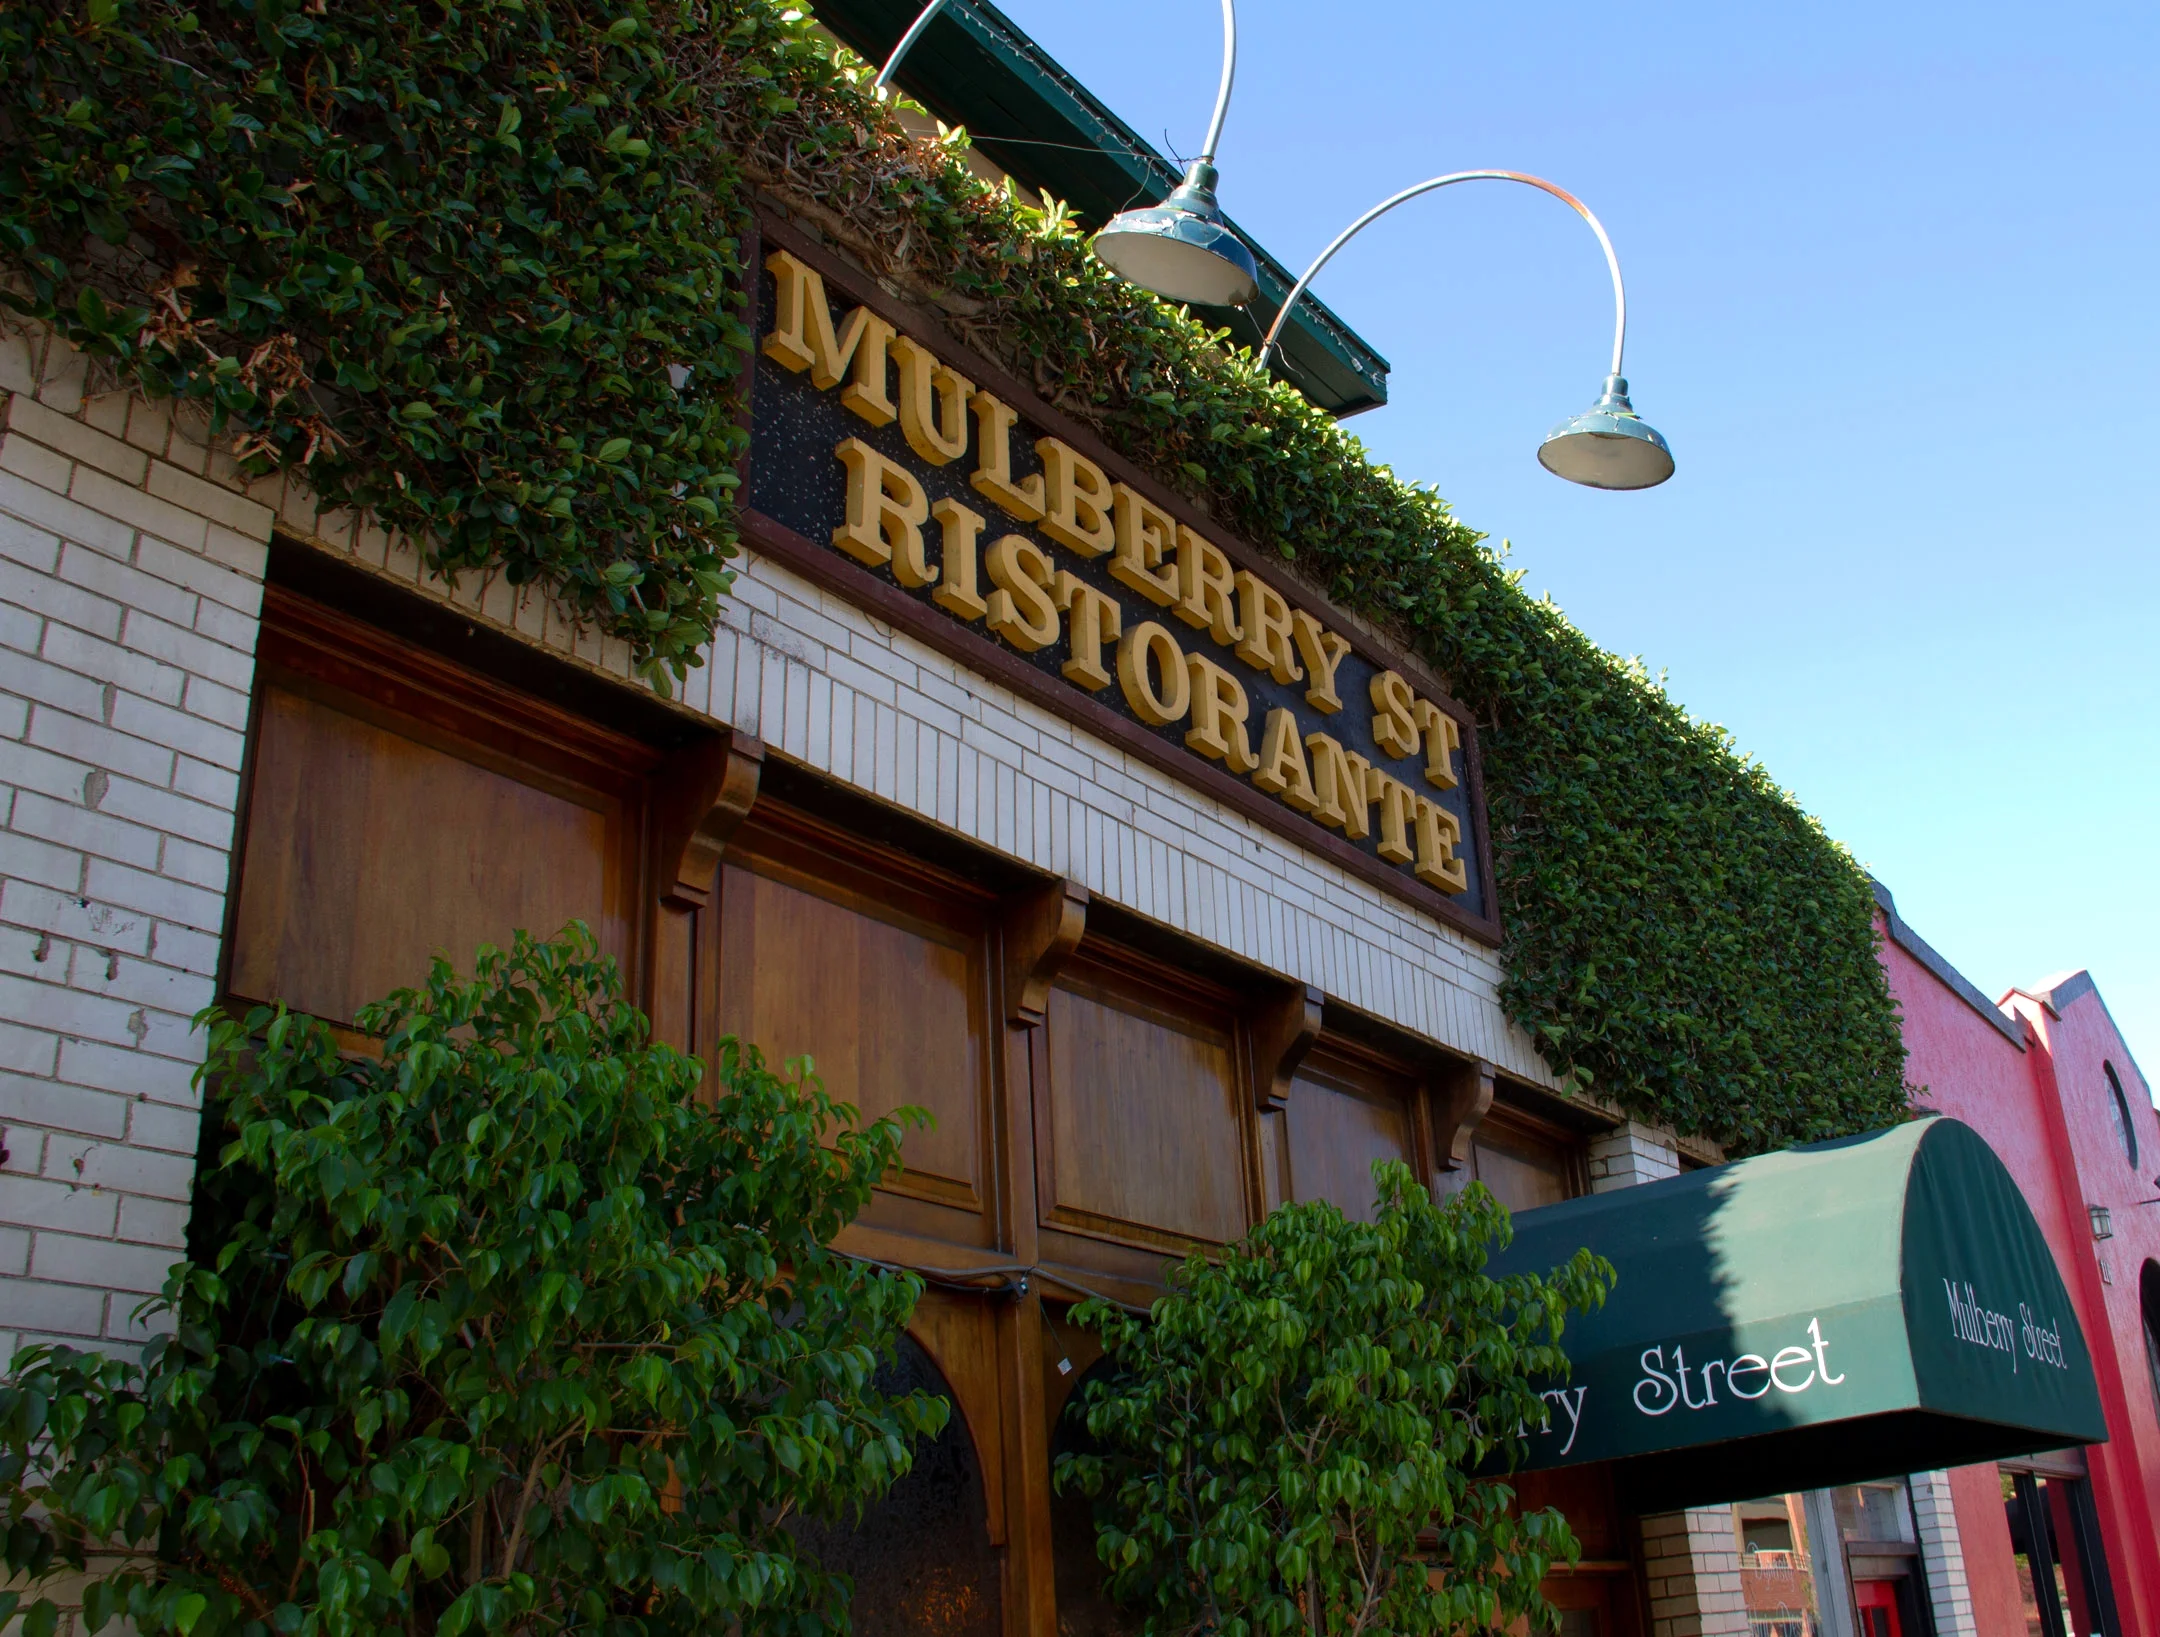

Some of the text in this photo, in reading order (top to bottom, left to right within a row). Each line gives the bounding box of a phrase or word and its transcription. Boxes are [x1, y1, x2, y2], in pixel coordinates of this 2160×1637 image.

[763, 250, 1460, 790] MULBERRY ST
[833, 438, 1467, 894] RISTORANTE
[1633, 1317, 1845, 1416] Street
[1943, 1278, 2067, 1374] Mulberry Street
